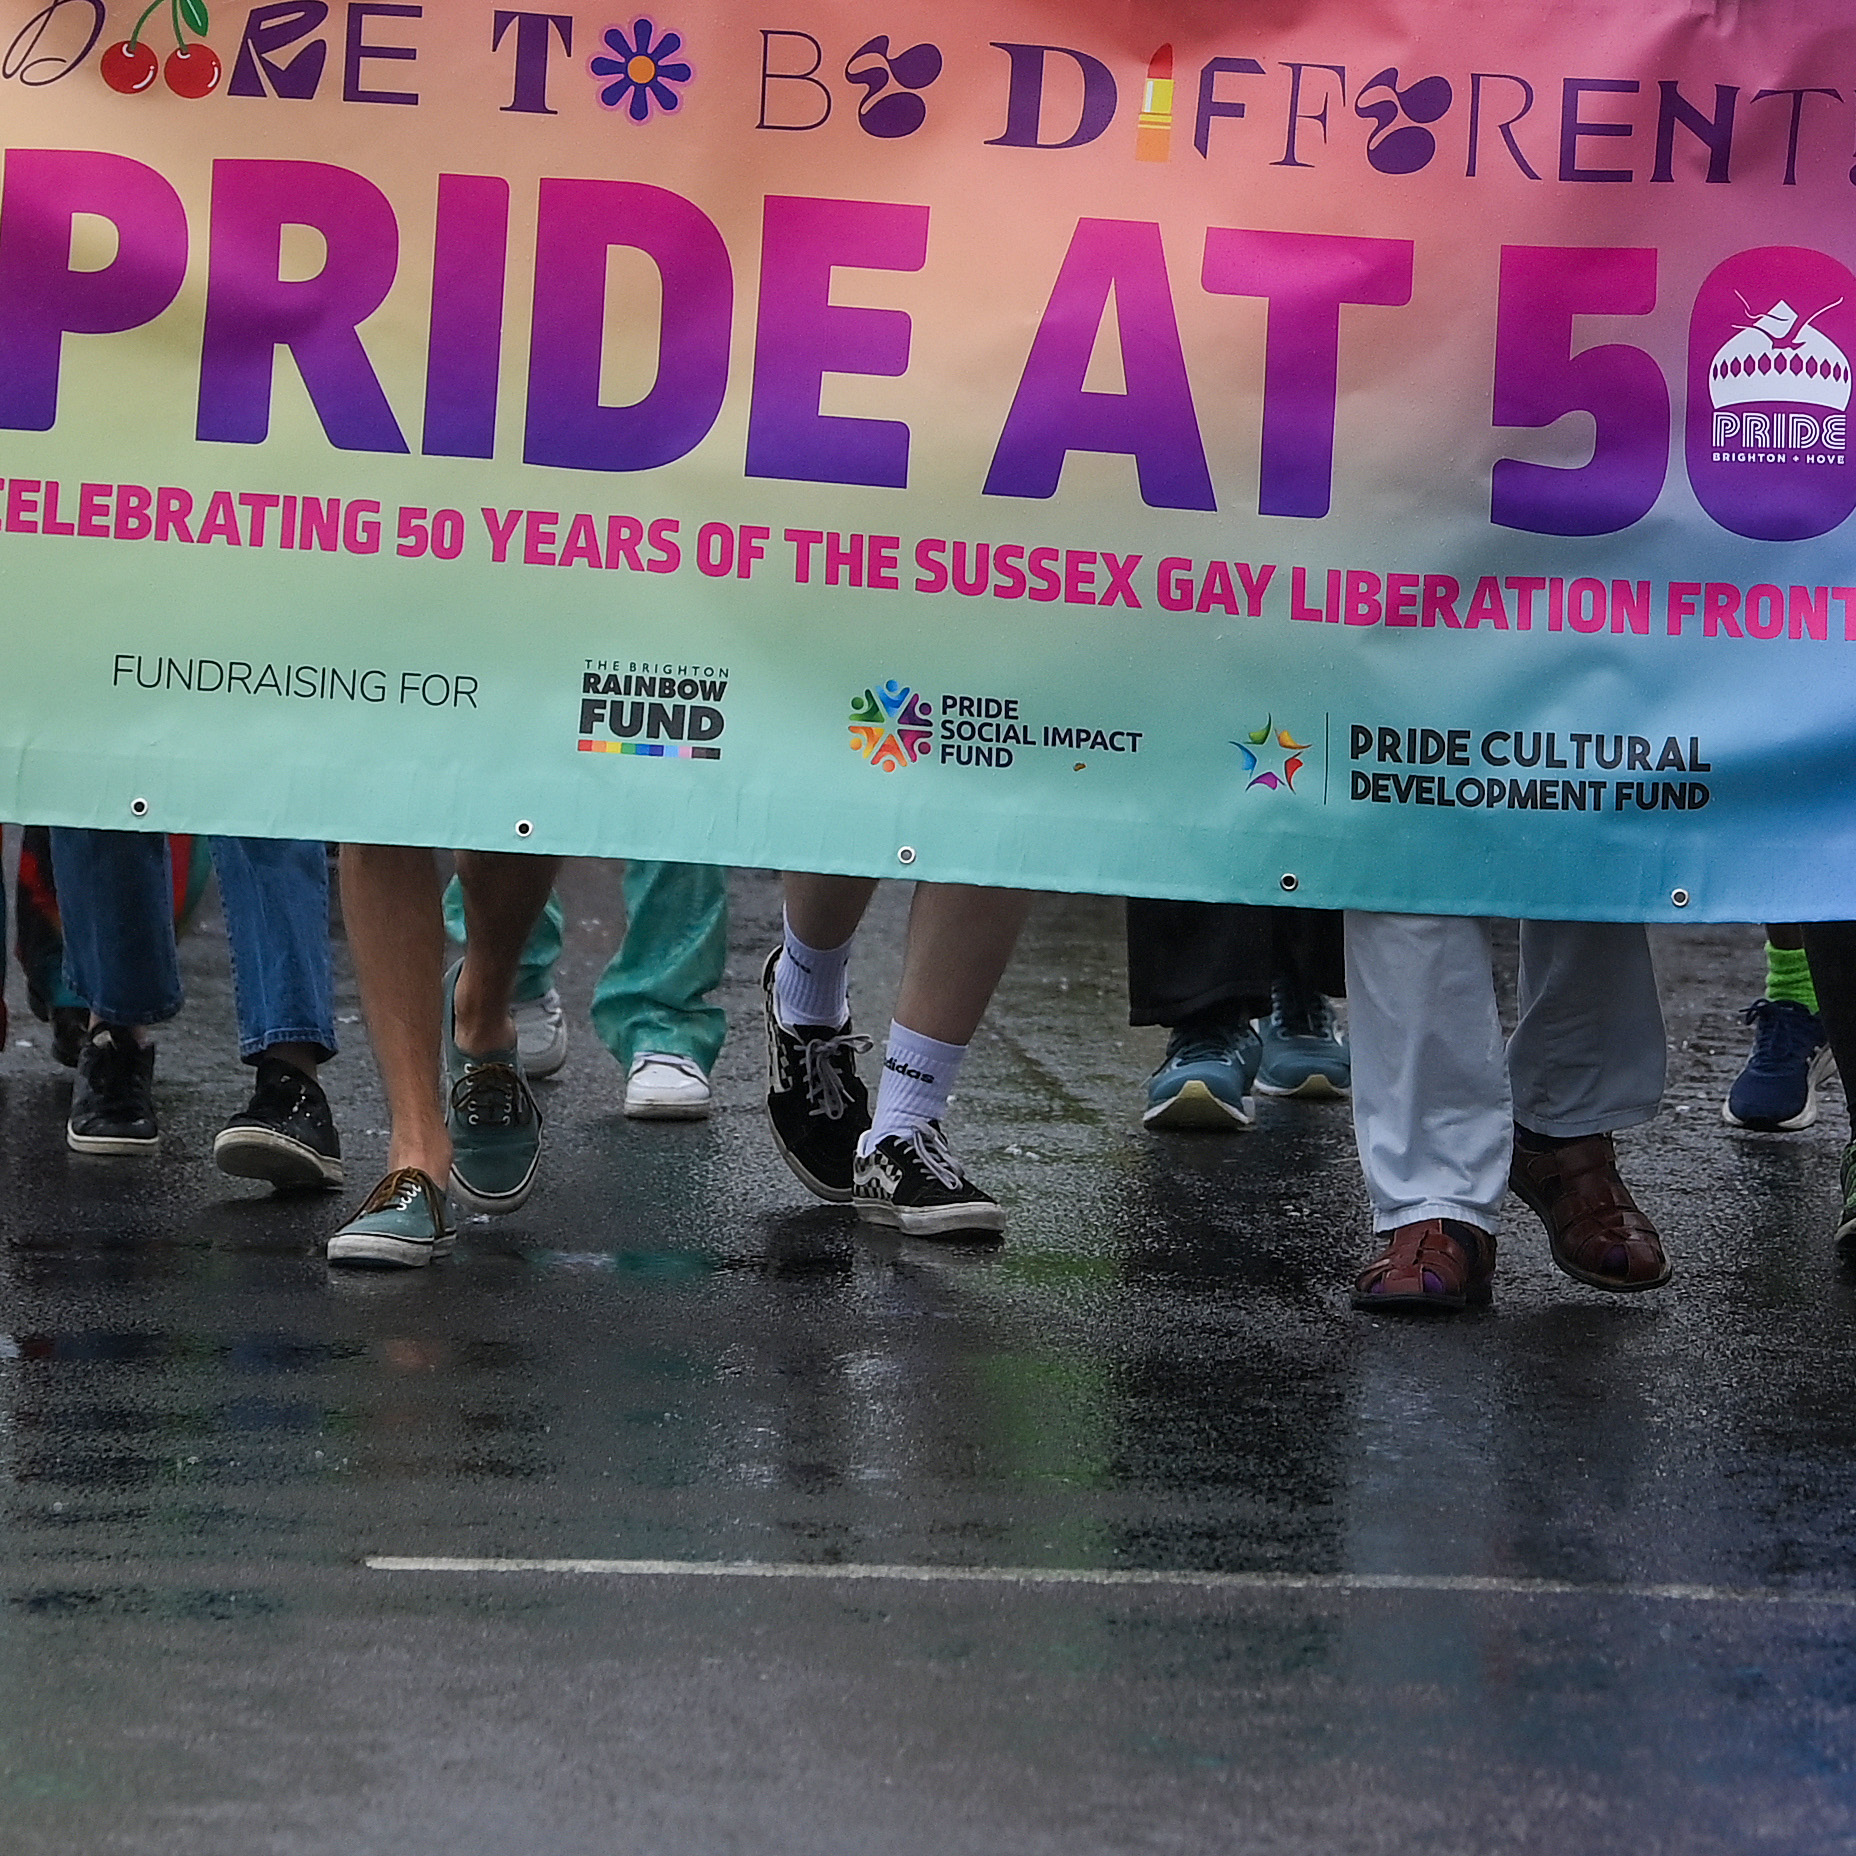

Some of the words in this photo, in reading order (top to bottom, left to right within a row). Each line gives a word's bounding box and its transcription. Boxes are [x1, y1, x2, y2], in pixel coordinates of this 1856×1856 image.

[981, 217, 1415, 519] AT
[1712, 411, 1847, 451] PRIDE
[1712, 452, 1786, 464] BRIGHTON
[1805, 454, 1845, 465] HOVE
[396, 506, 464, 560] 50
[480, 508, 681, 574] YEARS
[696, 522, 770, 580] OF
[784, 530, 900, 591] THE
[914, 539, 1142, 609] SUSSEX
[1156, 557, 1276, 618] GAY
[1289, 565, 1650, 637] LIBERATION
[112, 654, 387, 704] FUNDRAISING
[398, 673, 480, 710] FOR
[582, 672, 728, 702] RAINBOW
[584, 659, 620, 672] THE
[629, 662, 729, 679] BRIGHTON
[578, 698, 725, 742] FUND
[941, 695, 1019, 720] PRIDE
[939, 719, 1037, 746] SOCIAL
[1042, 726, 1143, 754] IMPACT
[939, 744, 1014, 769] FUND
[1350, 724, 1472, 768] PRIDE
[1480, 728, 1710, 773] CULTURAL
[1350, 770, 1609, 811] DEVELOPMENT
[1615, 776, 1710, 811] FUND
